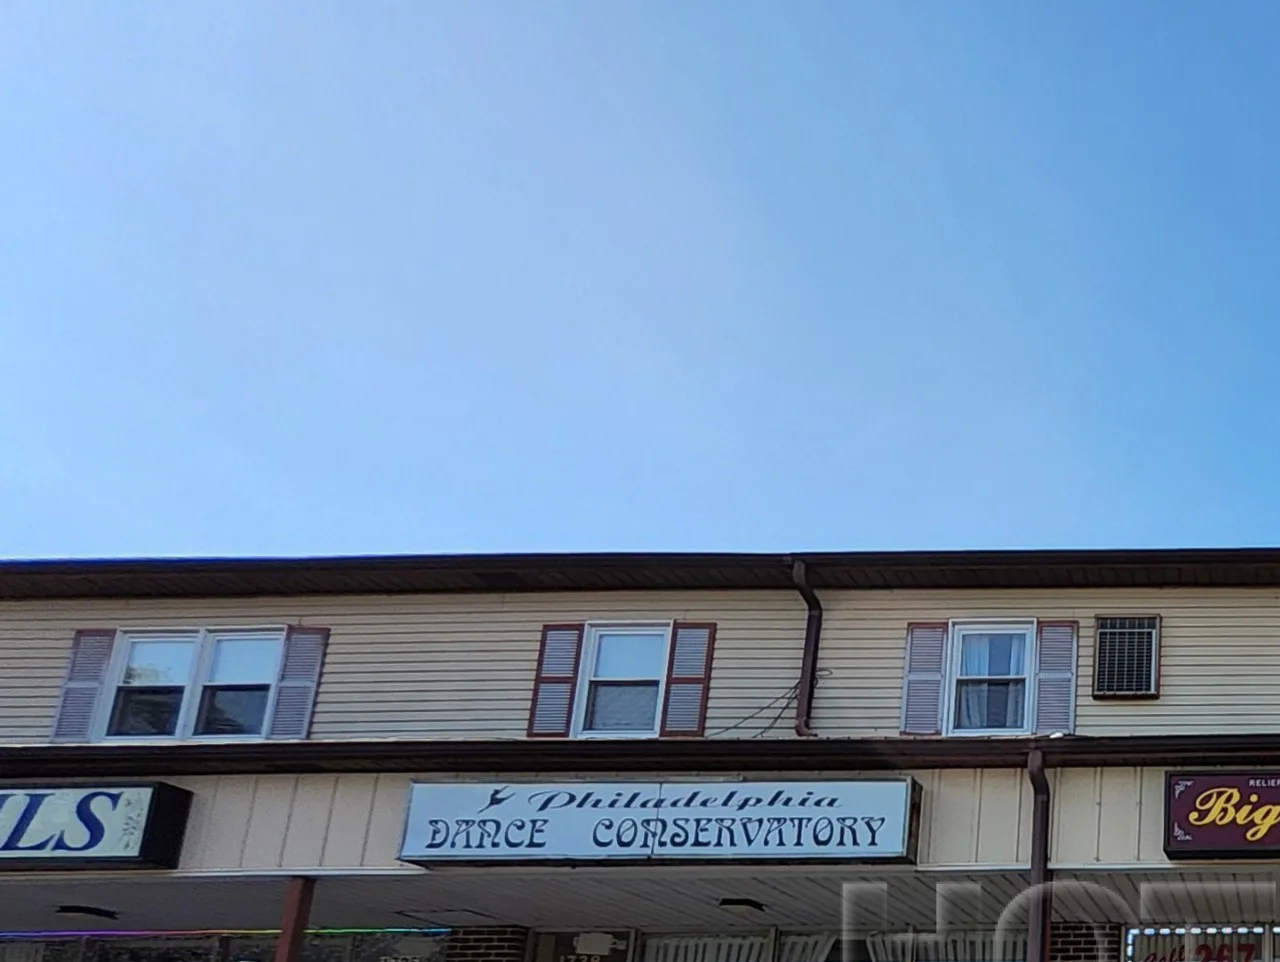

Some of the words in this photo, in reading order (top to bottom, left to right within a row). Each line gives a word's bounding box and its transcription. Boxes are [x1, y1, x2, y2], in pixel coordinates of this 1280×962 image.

[528, 790, 842, 812] Philadelphia
[425, 819, 549, 849] DANCE
[592, 816, 886, 848] CONSERVATORY
